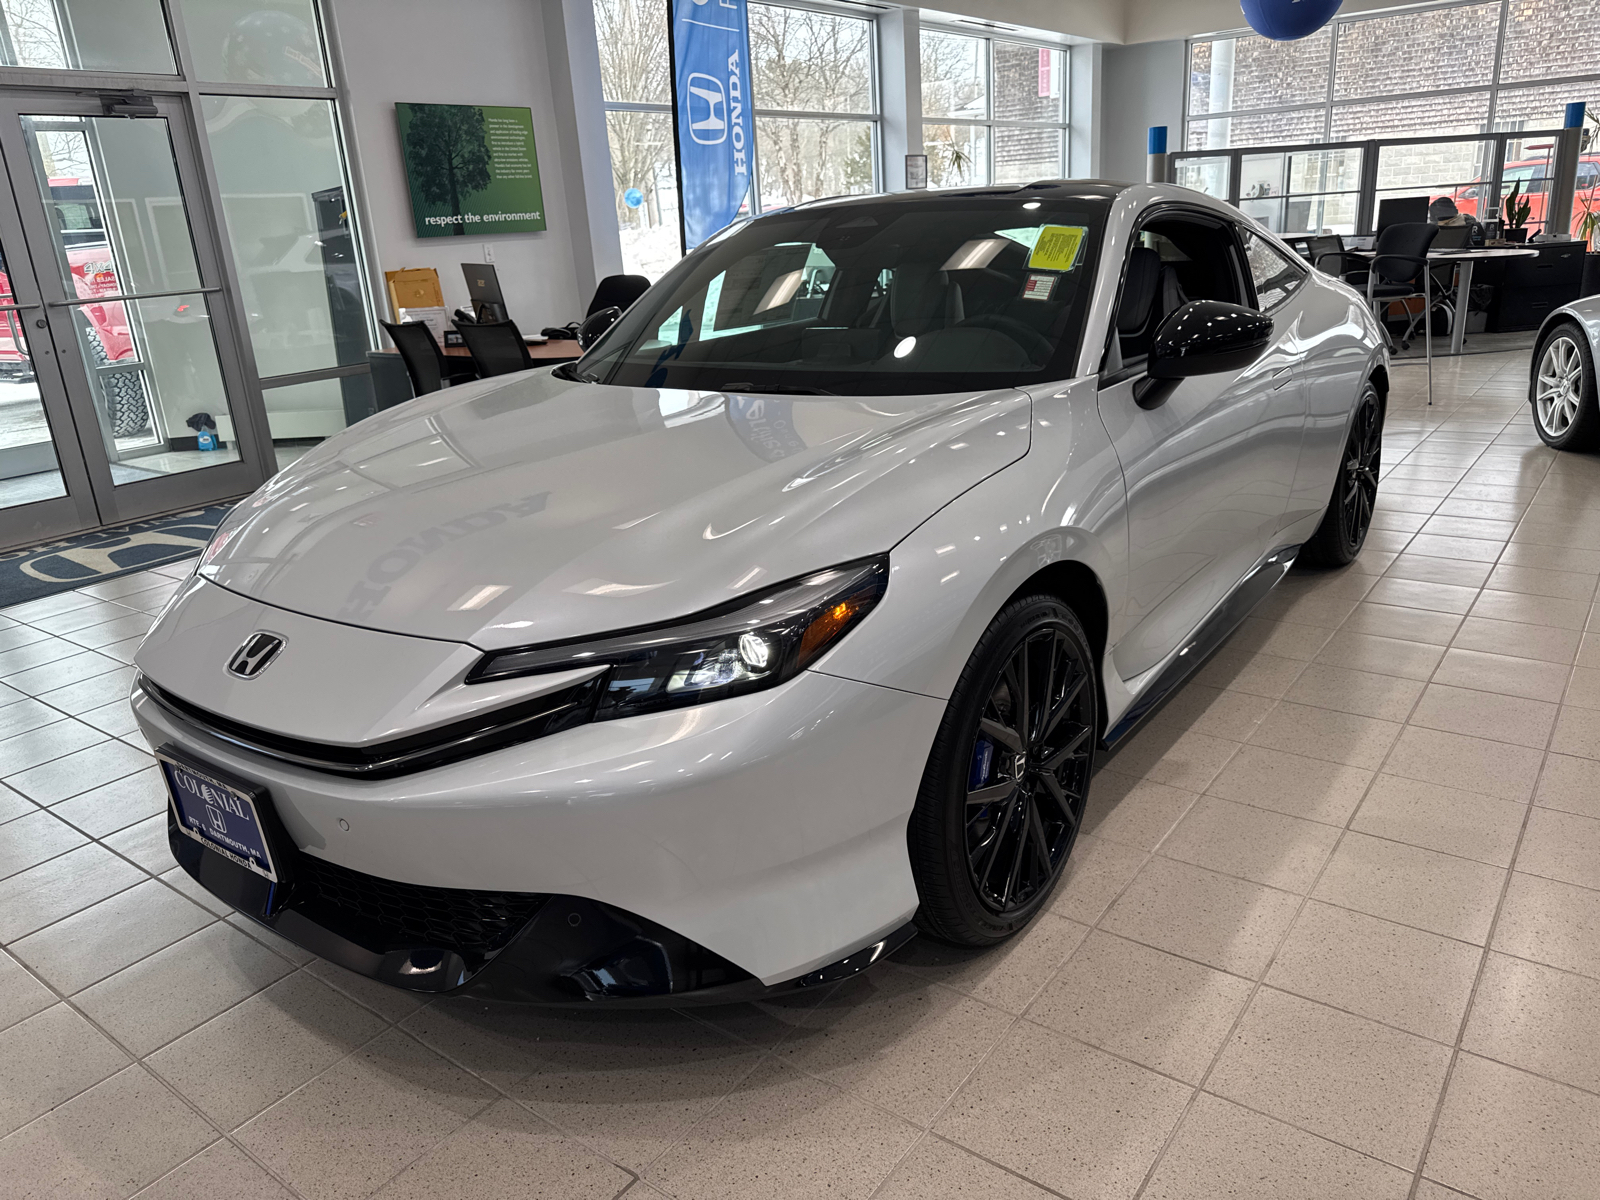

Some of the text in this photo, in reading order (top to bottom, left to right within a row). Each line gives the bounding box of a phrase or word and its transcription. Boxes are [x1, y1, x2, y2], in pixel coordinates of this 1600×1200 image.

[728, 49, 747, 176] HONDA
[425, 211, 541, 227] respect the environment
[174, 770, 249, 821] COLONIAL
[250, 848, 262, 859] MA
